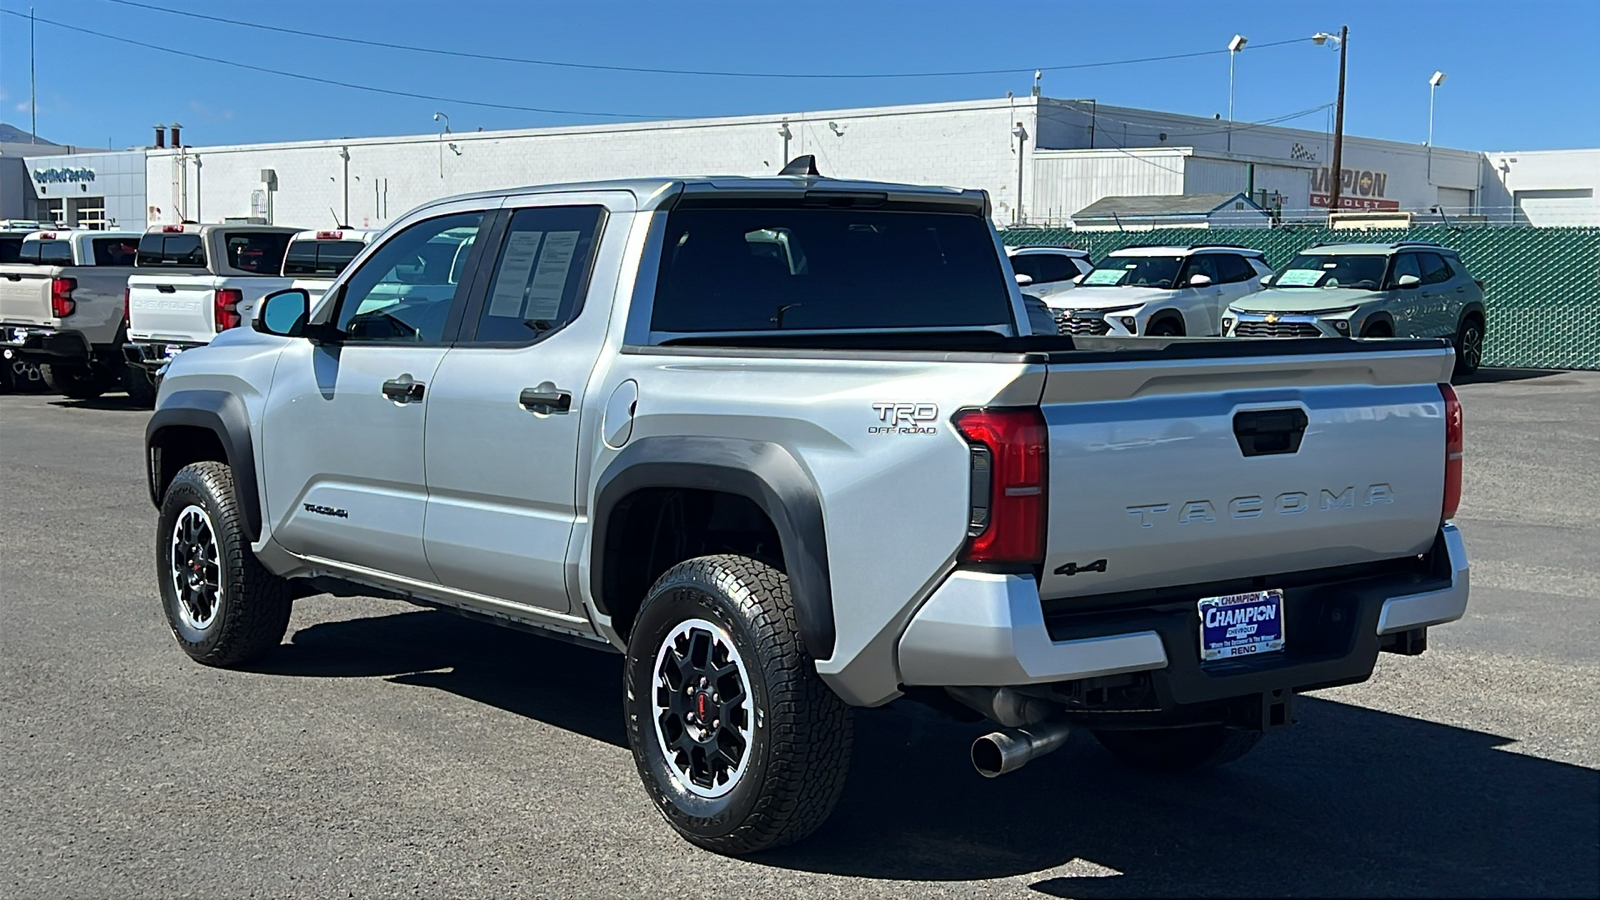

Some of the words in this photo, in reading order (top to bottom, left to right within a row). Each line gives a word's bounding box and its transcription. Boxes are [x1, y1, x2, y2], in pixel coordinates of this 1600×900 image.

[1313, 197, 1380, 209] EVOLET
[872, 402, 938, 426] TRD
[868, 426, 897, 434] OFF
[898, 427, 937, 435] ROAD
[1126, 483, 1394, 527] TACOMA
[1221, 593, 1260, 606] CHAMPION
[1205, 604, 1276, 628] CHAMPION
[1231, 645, 1257, 656] RENO
